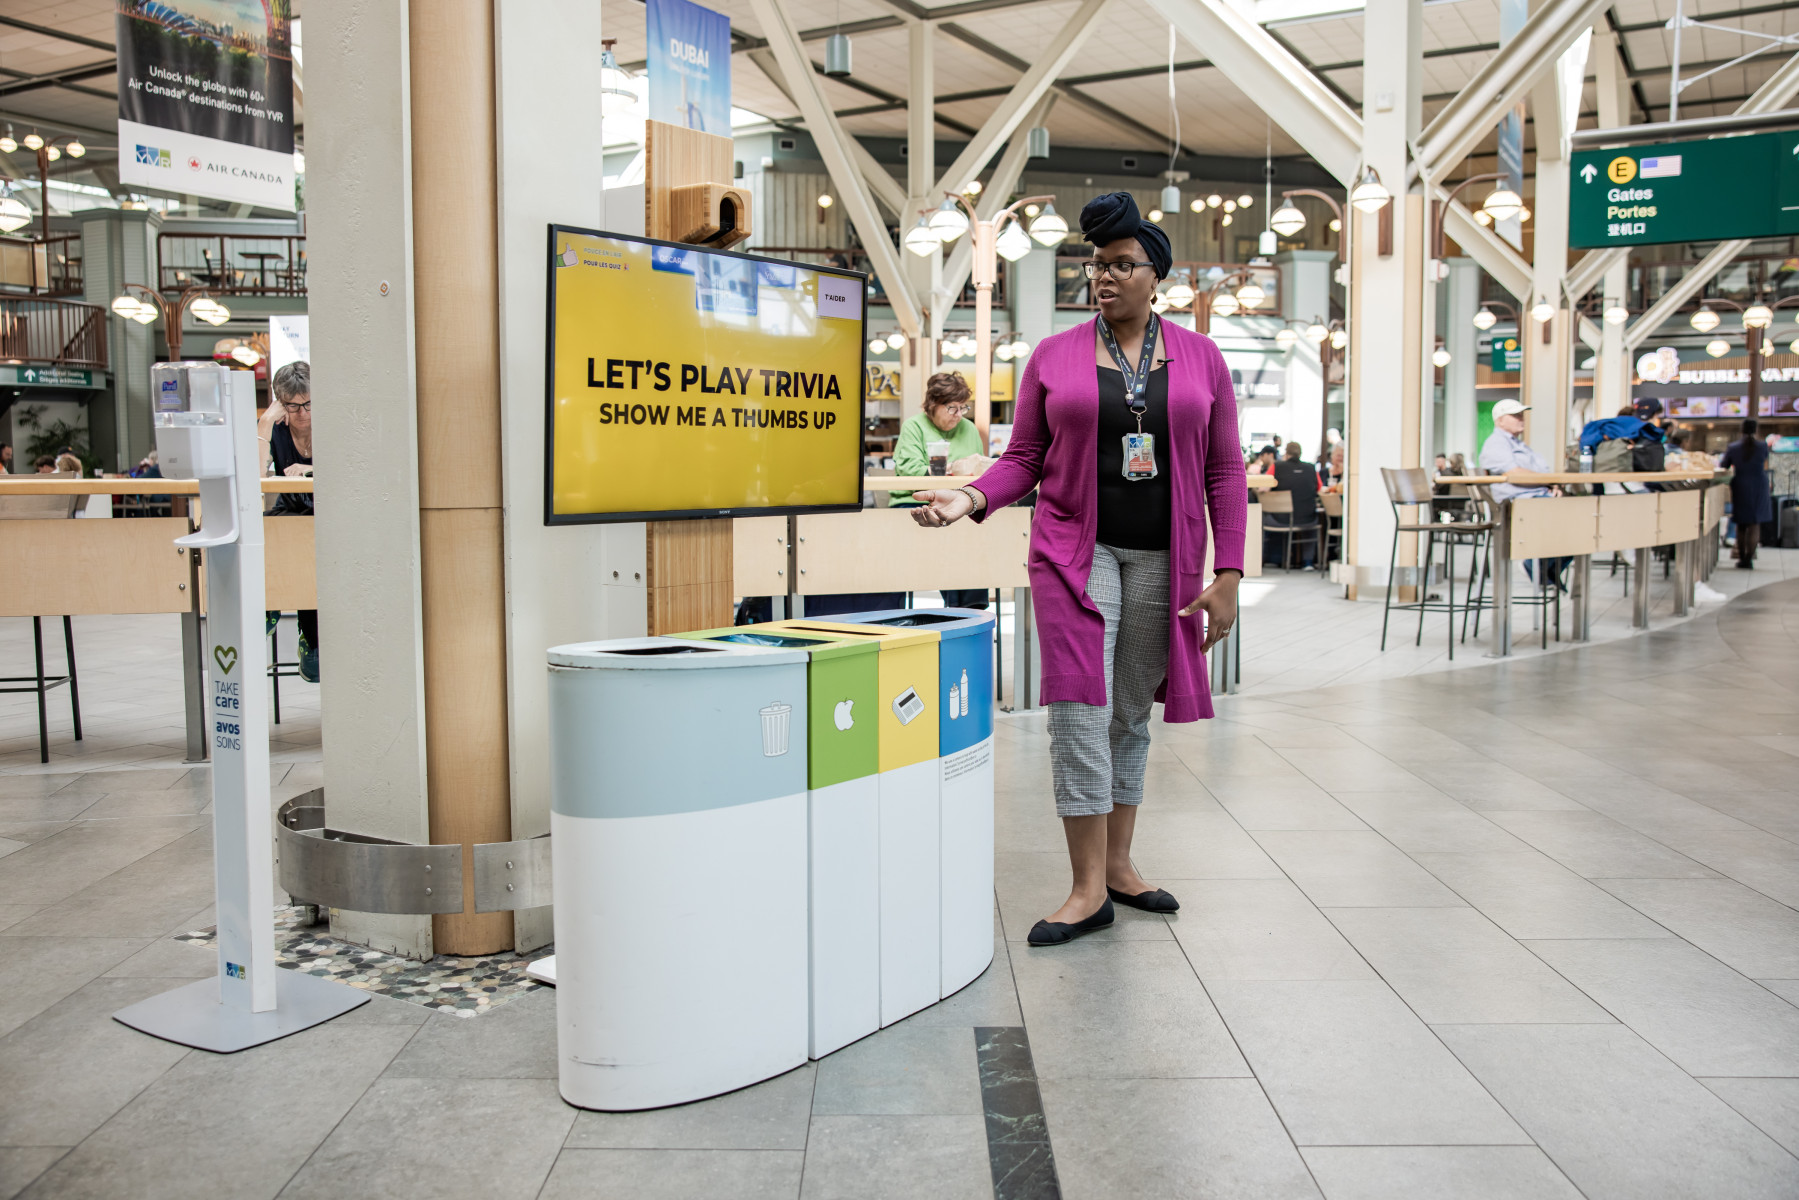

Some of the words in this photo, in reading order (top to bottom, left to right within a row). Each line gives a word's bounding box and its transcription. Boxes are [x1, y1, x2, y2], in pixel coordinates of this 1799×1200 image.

[670, 38, 709, 68] DUBAI
[149, 65, 183, 84] Unlock
[185, 75, 200, 88] the
[202, 79, 227, 95] globe
[229, 87, 248, 99] with
[249, 89, 265, 102] 60+
[128, 77, 143, 90] Air
[189, 92, 243, 114] destinations
[244, 105, 265, 119] from
[266, 109, 284, 123] YVR
[136, 149, 171, 168] YVR
[207, 162, 228, 175] AIR
[231, 167, 283, 185] CANADA
[1615, 161, 1628, 178] E
[1607, 188, 1654, 203] Gates
[1607, 205, 1658, 220] Portes
[1607, 222, 1647, 237] 登机口
[583, 260, 598, 268] POUR
[599, 261, 608, 269] LES
[608, 262, 622, 270] QUIZ
[659, 255, 682, 266] OSCAR
[587, 357, 671, 392] LET'S
[681, 363, 753, 396] PLAY
[759, 369, 842, 400] TRIVIA
[1679, 368, 1752, 384] BUBBLE
[599, 402, 670, 426] SHOW
[676, 405, 707, 427] ME
[711, 407, 727, 427] A
[731, 408, 809, 429] THUMBS
[813, 411, 836, 430] UP
[214, 680, 239, 696] TAKE
[215, 695, 240, 710] care
[216, 721, 240, 735] avos
[216, 735, 241, 751] SOINS
